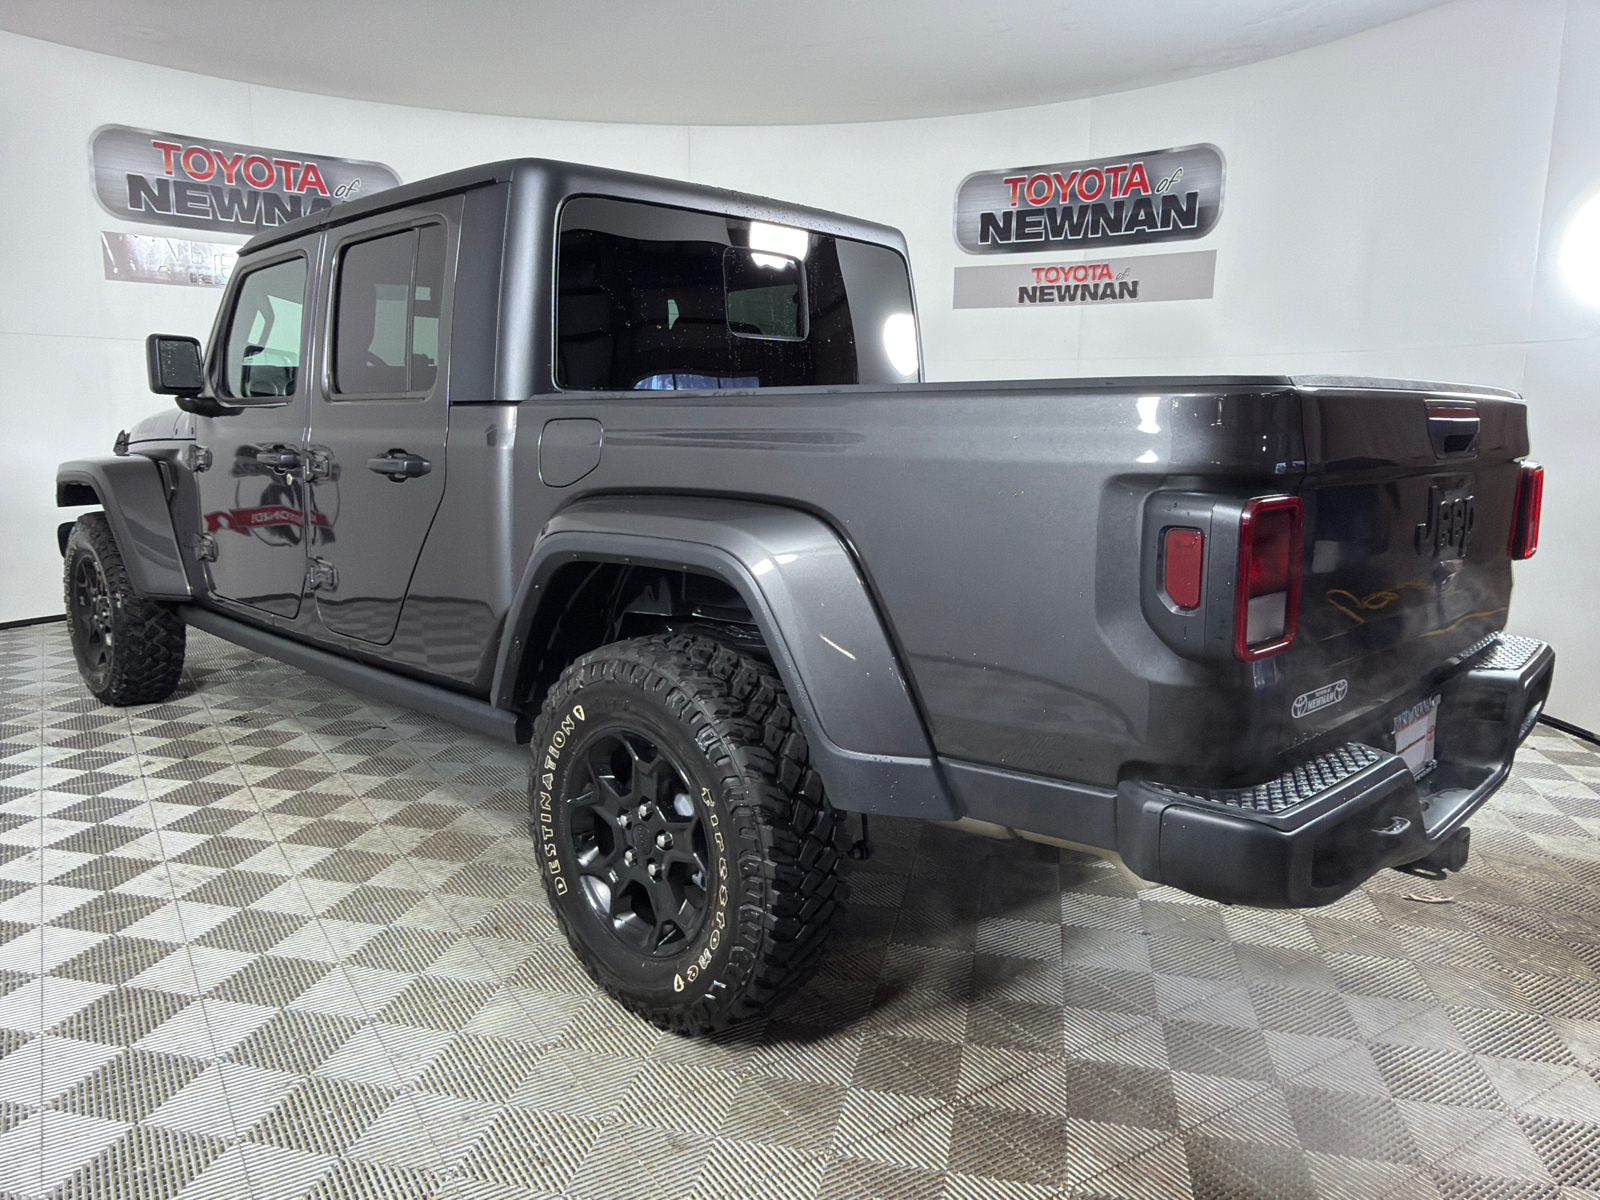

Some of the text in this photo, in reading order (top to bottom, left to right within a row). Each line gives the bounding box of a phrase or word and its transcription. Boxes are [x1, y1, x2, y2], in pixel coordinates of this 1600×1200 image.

[152, 140, 361, 198] TOYOTA of
[1004, 162, 1183, 207] TOYOTA of
[126, 173, 347, 226] NEWN
[978, 192, 1199, 245] NEWNAN
[1018, 280, 1139, 304] NEWNAN
[1032, 264, 1130, 284] TOYOTA of
[540, 714, 575, 896] DESTINATION
